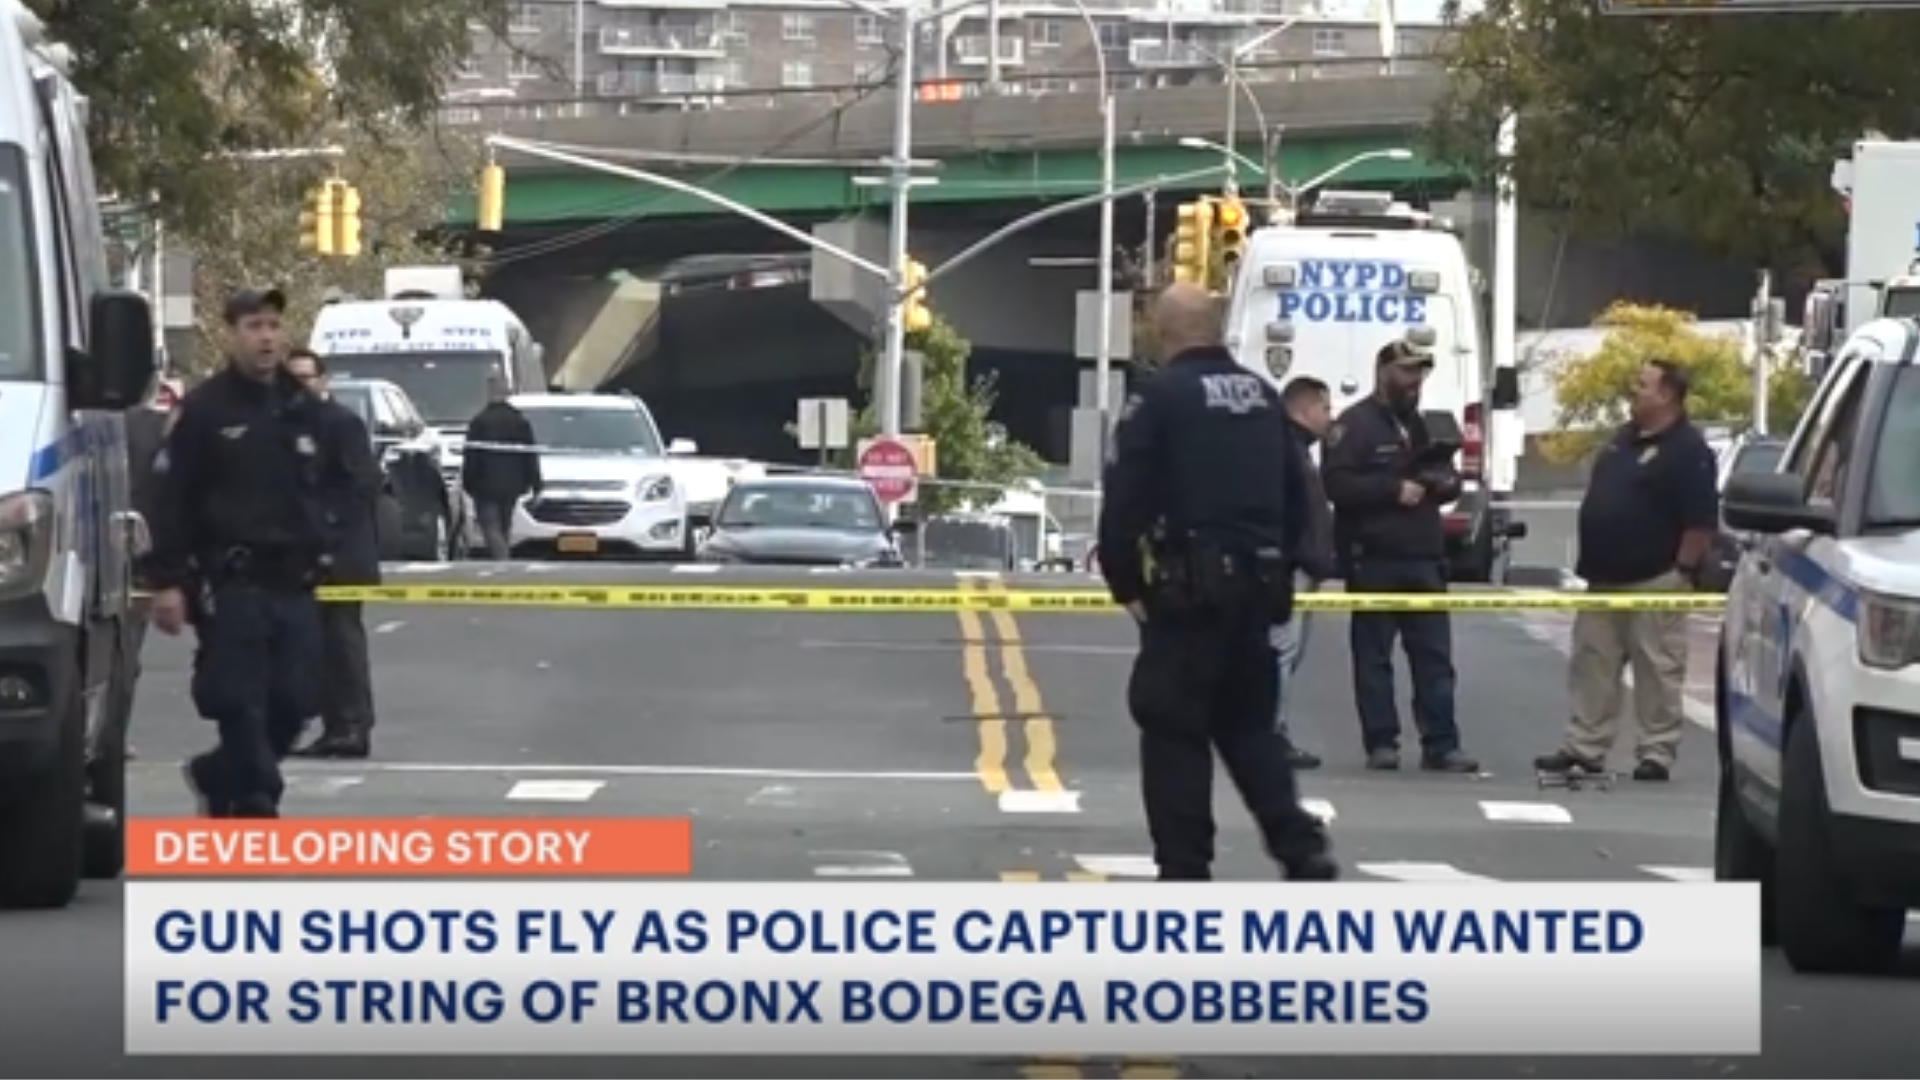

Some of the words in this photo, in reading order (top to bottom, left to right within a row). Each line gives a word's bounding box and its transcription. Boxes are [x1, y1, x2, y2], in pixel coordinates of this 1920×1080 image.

[1301, 260, 1405, 288] NYPD
[1277, 292, 1426, 323] POLICE
[1201, 373, 1262, 401] NYPD
